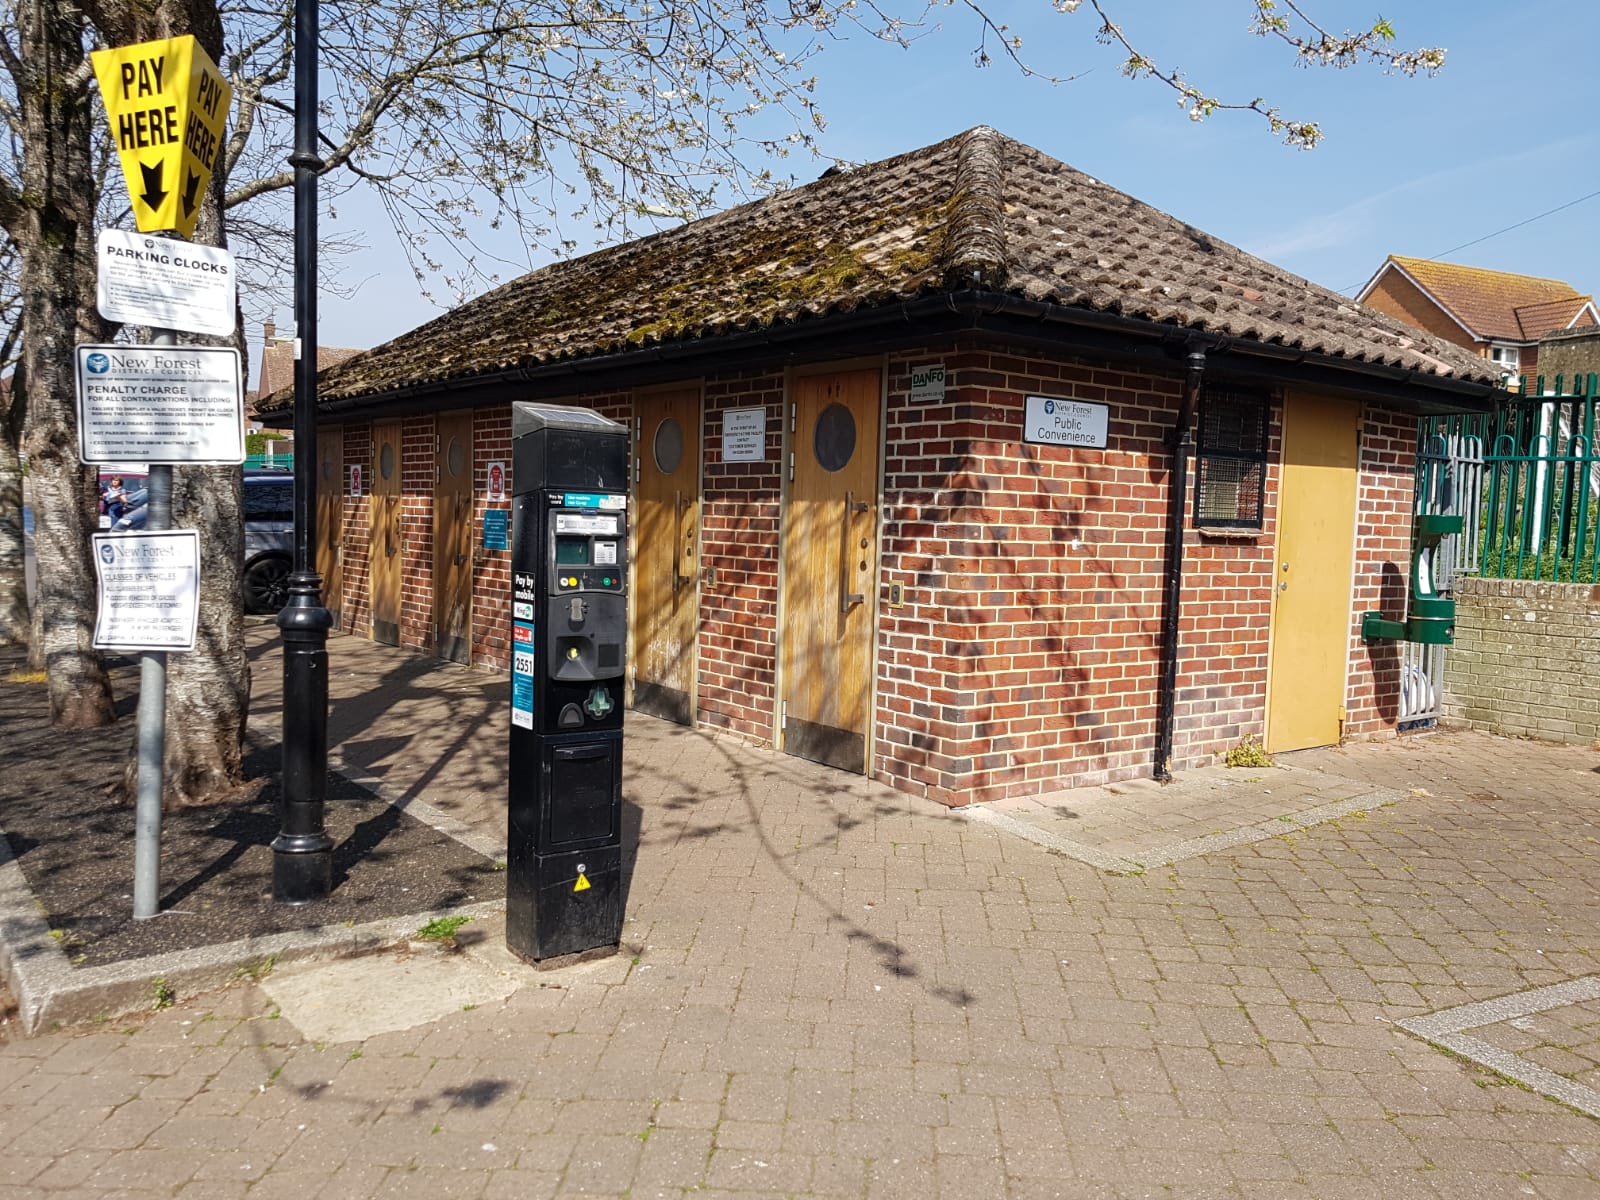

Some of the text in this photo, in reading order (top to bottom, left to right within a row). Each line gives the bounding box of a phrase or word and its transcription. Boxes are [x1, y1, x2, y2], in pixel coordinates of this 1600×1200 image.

[121, 56, 165, 100] PAY
[197, 69, 222, 120] PAY
[119, 105, 179, 150] HERE
[185, 110, 217, 171] HERE
[107, 246, 170, 265] PARKING
[173, 257, 228, 275] CLOCKS
[112, 355, 202, 369] New Forest
[913, 371, 944, 385] DANFO
[87, 385, 187, 395] PENALTY CHARGE
[1055, 402, 1092, 414] New Forest
[1054, 416, 1082, 430] Public
[1037, 427, 1096, 443] Convenience
[115, 544, 175, 557] New Forest
[515, 574, 534, 589] Pay by
[515, 588, 534, 601] mobile
[516, 657, 532, 673] 2551
